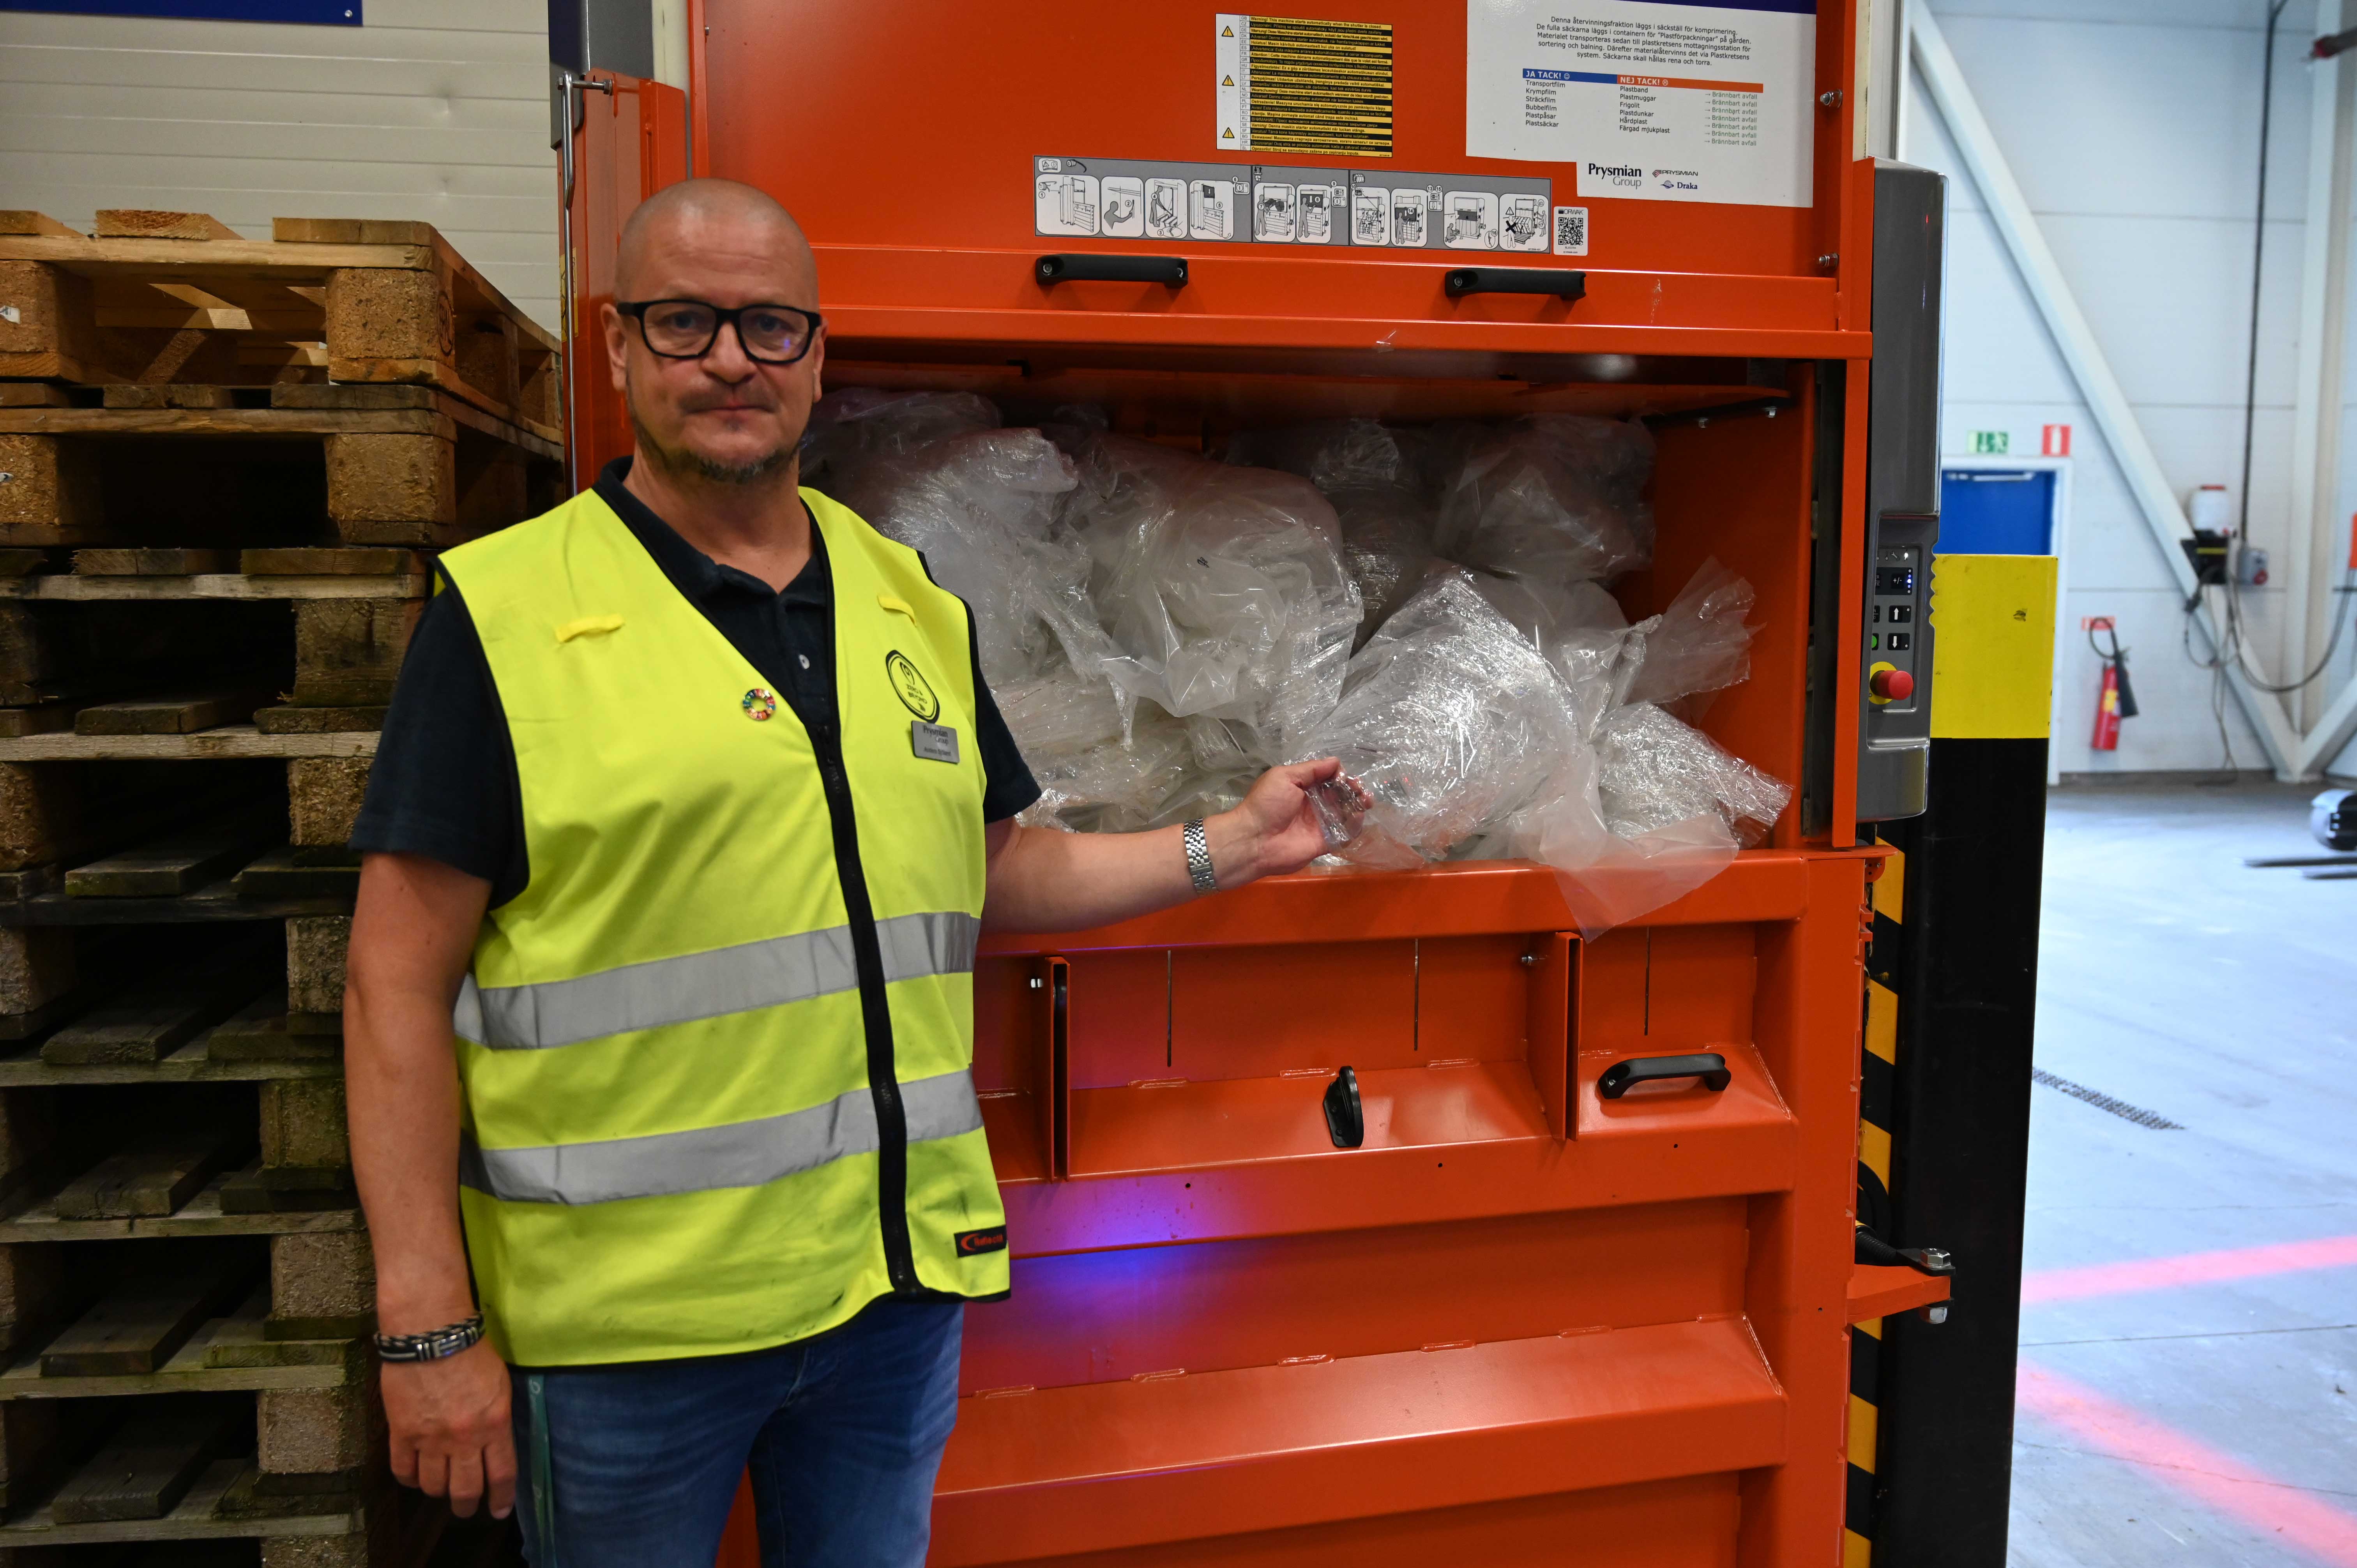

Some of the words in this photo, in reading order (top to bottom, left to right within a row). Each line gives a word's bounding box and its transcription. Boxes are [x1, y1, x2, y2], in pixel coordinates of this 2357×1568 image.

[1573, 17, 1633, 28] återvinningsfraktion
[1695, 26, 1737, 36] komprimering.
[1581, 43, 1604, 51] balning.
[1620, 94, 1656, 102] Plastmuggar
[1589, 163, 1641, 179] Prysmian
[1613, 177, 1641, 189] Group
[923, 725, 948, 737] Prysmian
